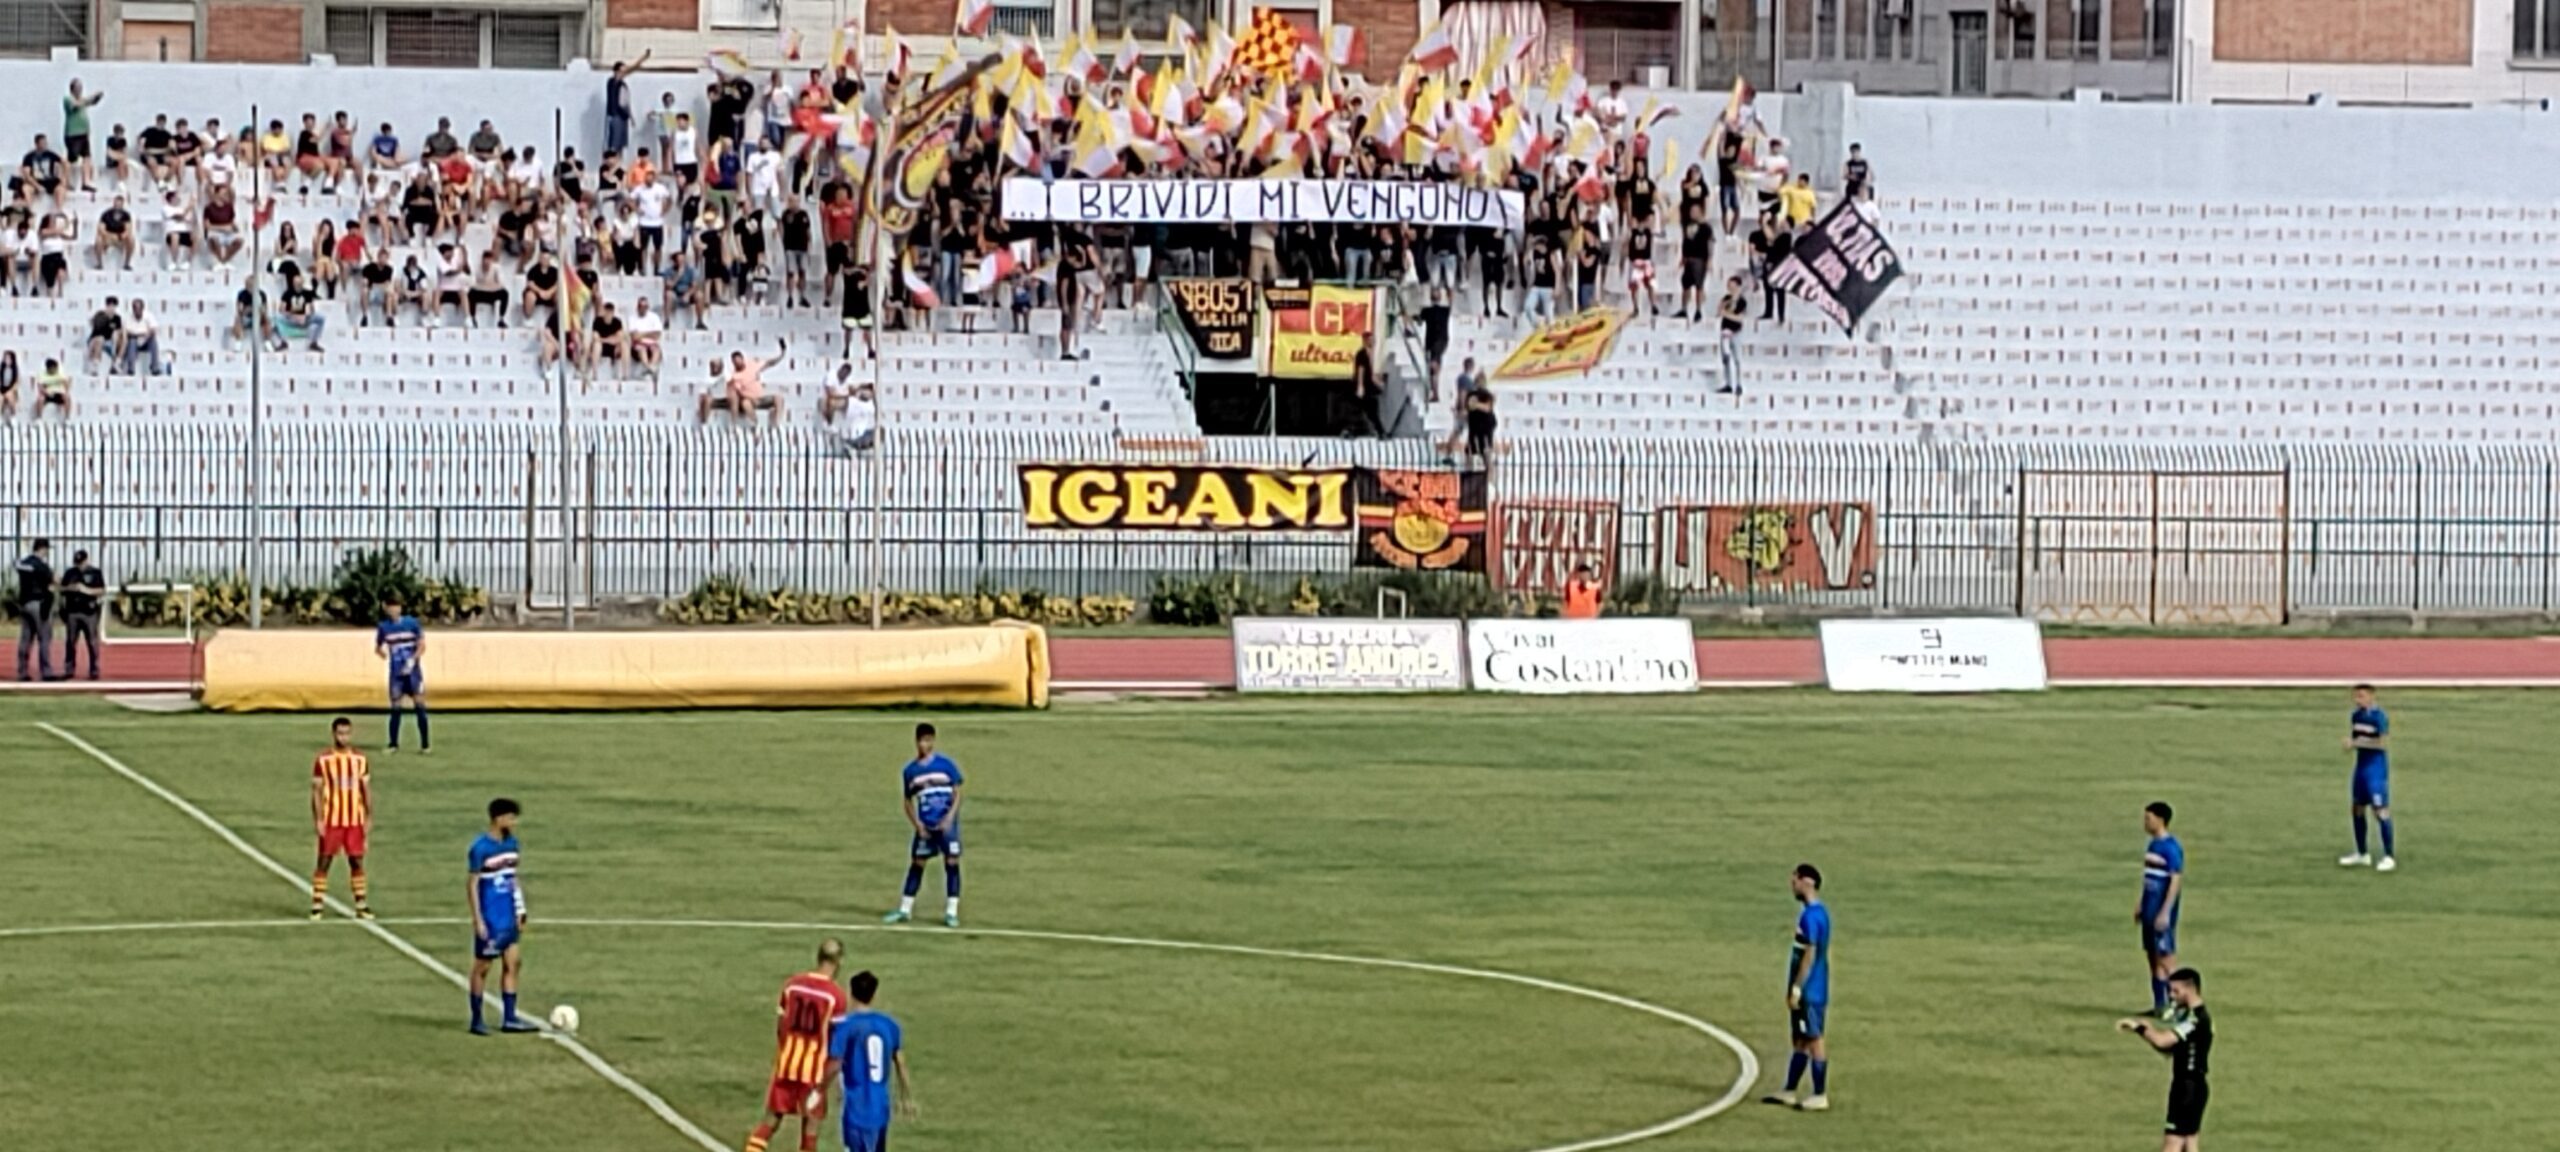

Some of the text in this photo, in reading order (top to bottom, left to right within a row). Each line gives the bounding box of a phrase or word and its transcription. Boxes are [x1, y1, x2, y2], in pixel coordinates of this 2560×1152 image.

[1080, 182, 1232, 219] BRIVIDI
[1259, 181, 1300, 219] MI
[1290, 342, 1355, 364] ultras
[1023, 470, 1348, 527] IGEANI
[1283, 624, 1412, 645] VETRERIA
[1243, 645, 1337, 677] TORRE
[1485, 649, 1689, 684] Costantino
[867, 1034, 884, 1084] 9
